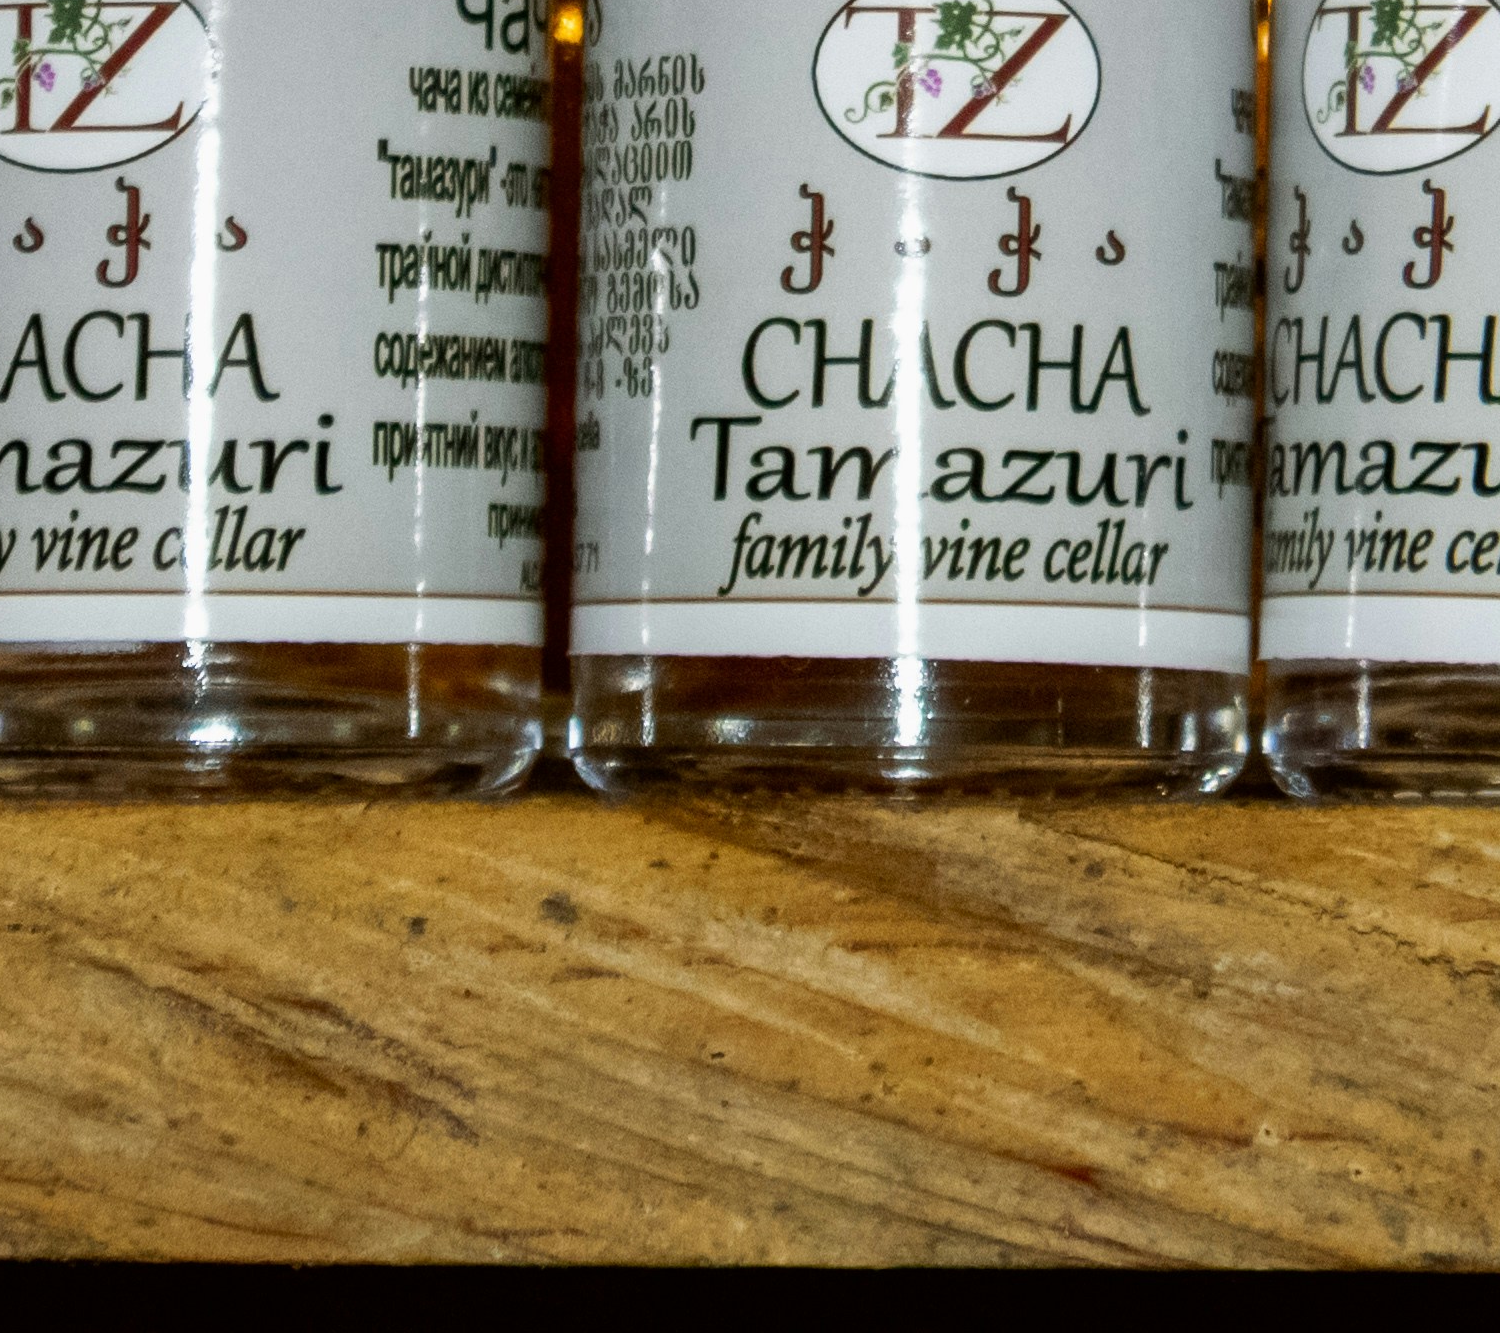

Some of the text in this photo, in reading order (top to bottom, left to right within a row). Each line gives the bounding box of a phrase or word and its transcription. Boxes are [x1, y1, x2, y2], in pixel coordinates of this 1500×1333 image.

[408, 65, 462, 114] чача
[467, 70, 490, 116] из
[631, 98, 697, 143] არის
[741, 316, 1152, 417] CHACHA
[689, 415, 1195, 512] Tamazuri
[30, 509, 139, 573] vine
[152, 504, 307, 573] cllar
[717, 511, 1170, 597] family vine cellar
[1266, 506, 1336, 591] mily
[1343, 508, 1435, 575] vine
